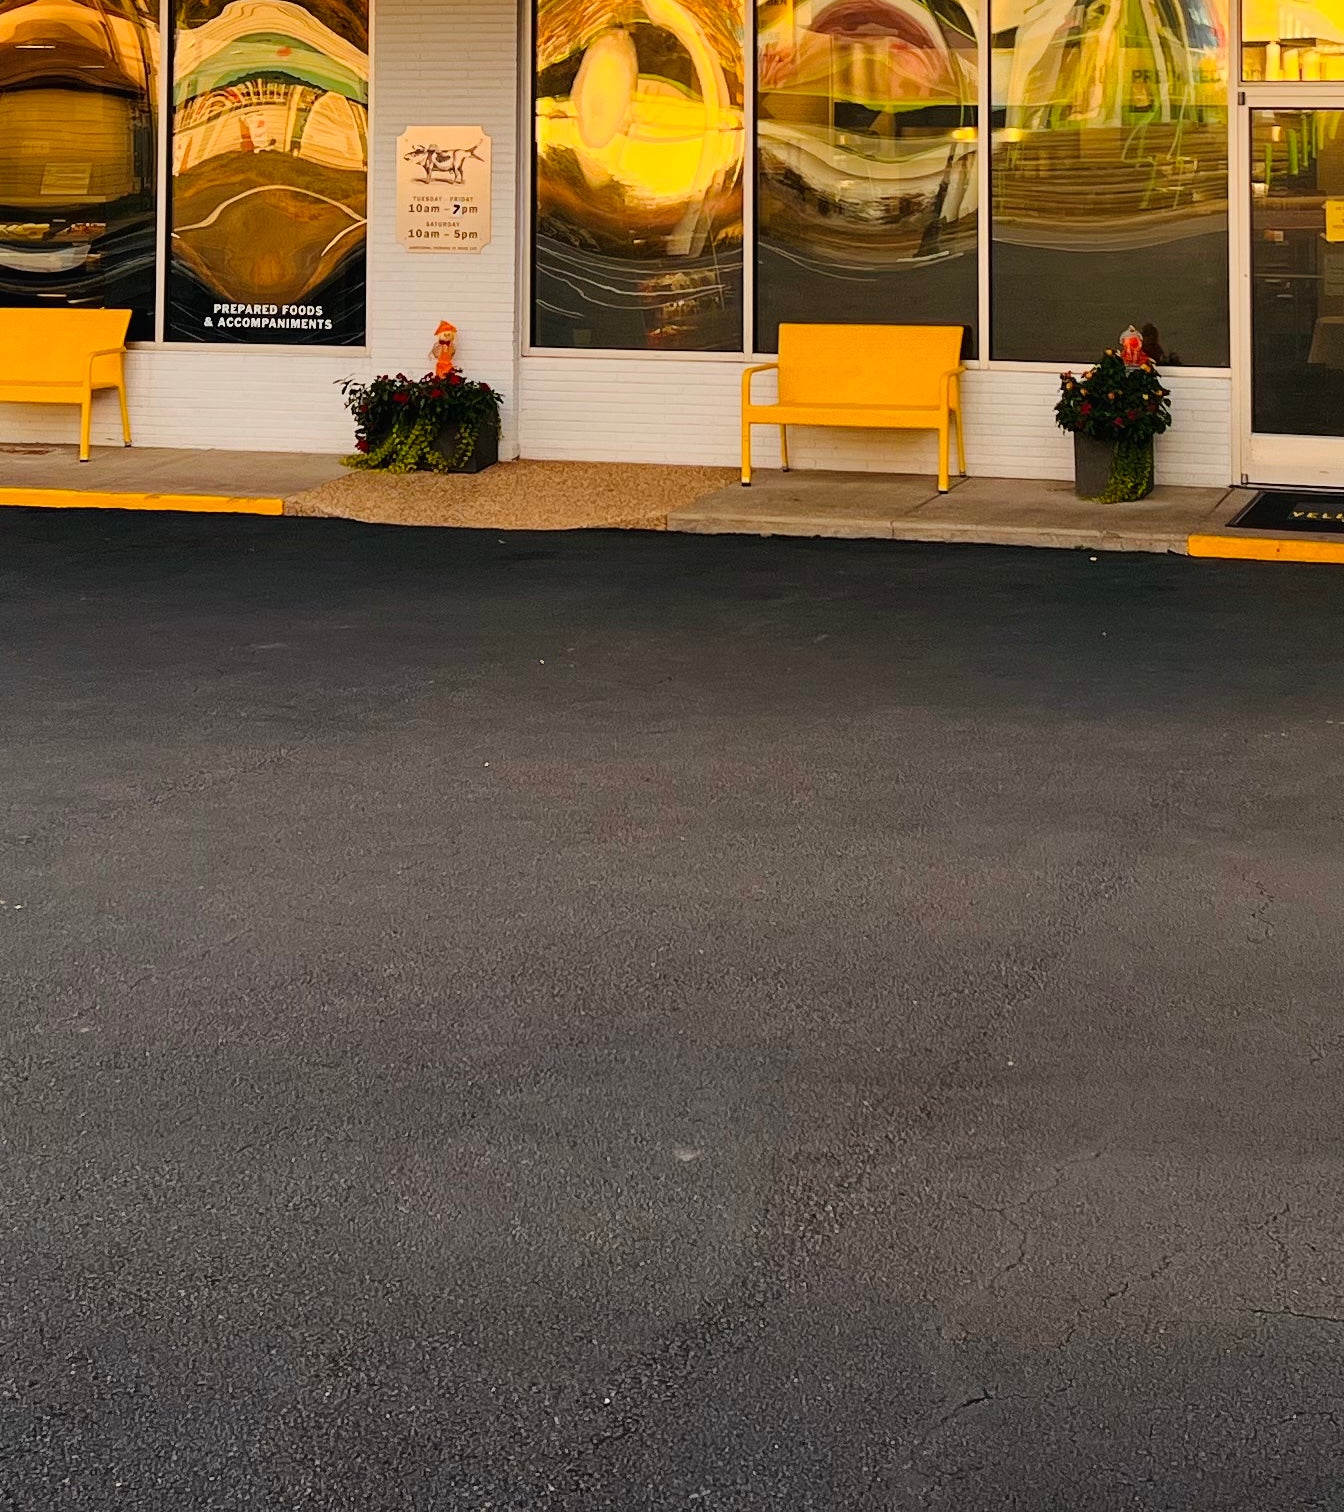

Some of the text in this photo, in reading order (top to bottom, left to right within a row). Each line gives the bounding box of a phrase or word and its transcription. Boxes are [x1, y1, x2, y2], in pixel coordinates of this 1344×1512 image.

[408, 203, 440, 213] 10am
[452, 203, 478, 215] 7pm
[408, 228, 440, 239] 10am
[454, 229, 478, 240] 5pm
[213, 303, 324, 317] PREPARED FOODS
[203, 316, 333, 330] & ACCOMPANIMENTS
